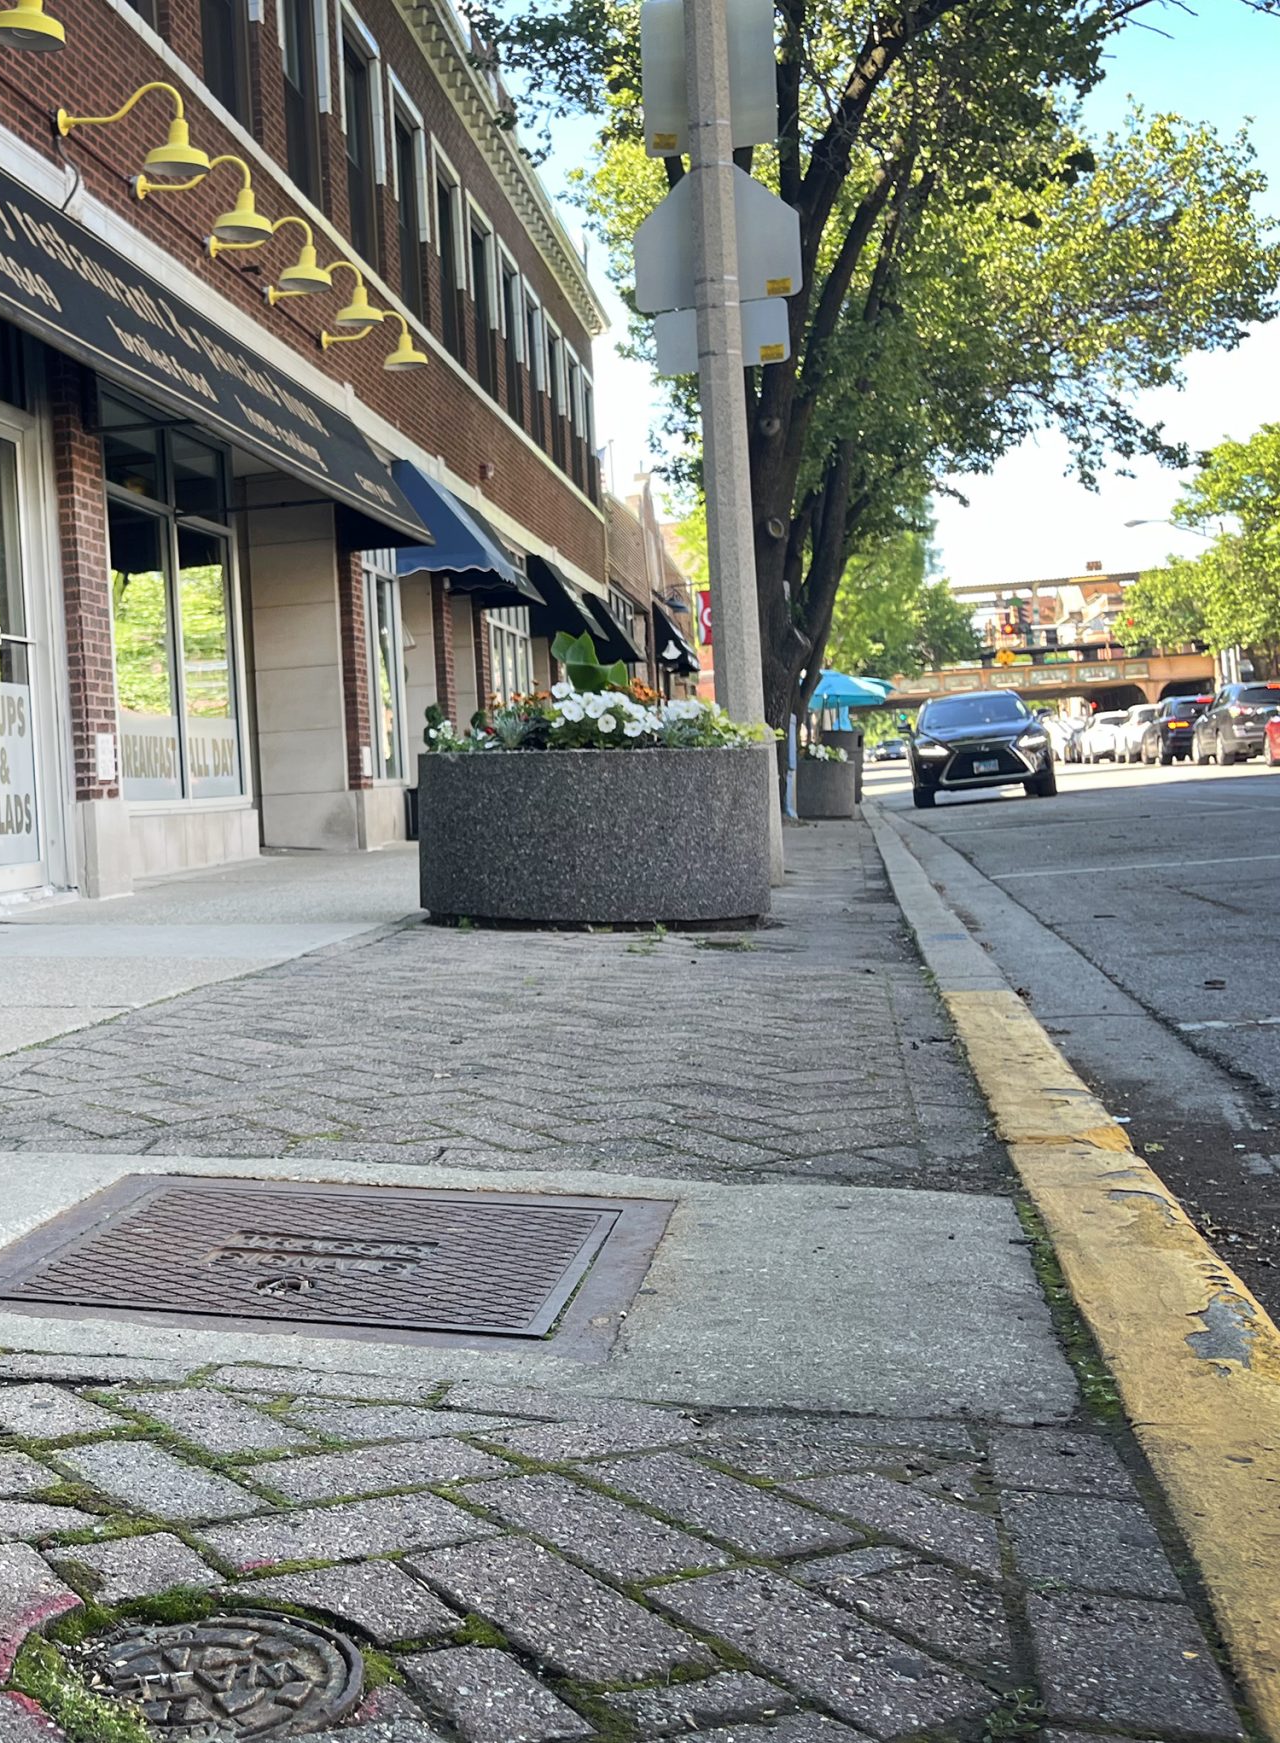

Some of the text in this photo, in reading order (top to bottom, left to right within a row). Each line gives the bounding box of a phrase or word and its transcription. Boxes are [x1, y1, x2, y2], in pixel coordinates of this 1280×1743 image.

[6, 201, 175, 337] restaurant
[158, 298, 201, 354] &
[189, 326, 283, 408] pancake
[106, 315, 219, 403] broiled food
[0, 747, 11, 785] &
[119, 734, 177, 779] REAKFAST
[189, 737, 209, 777] ALL
[211, 738, 234, 777] DAY
